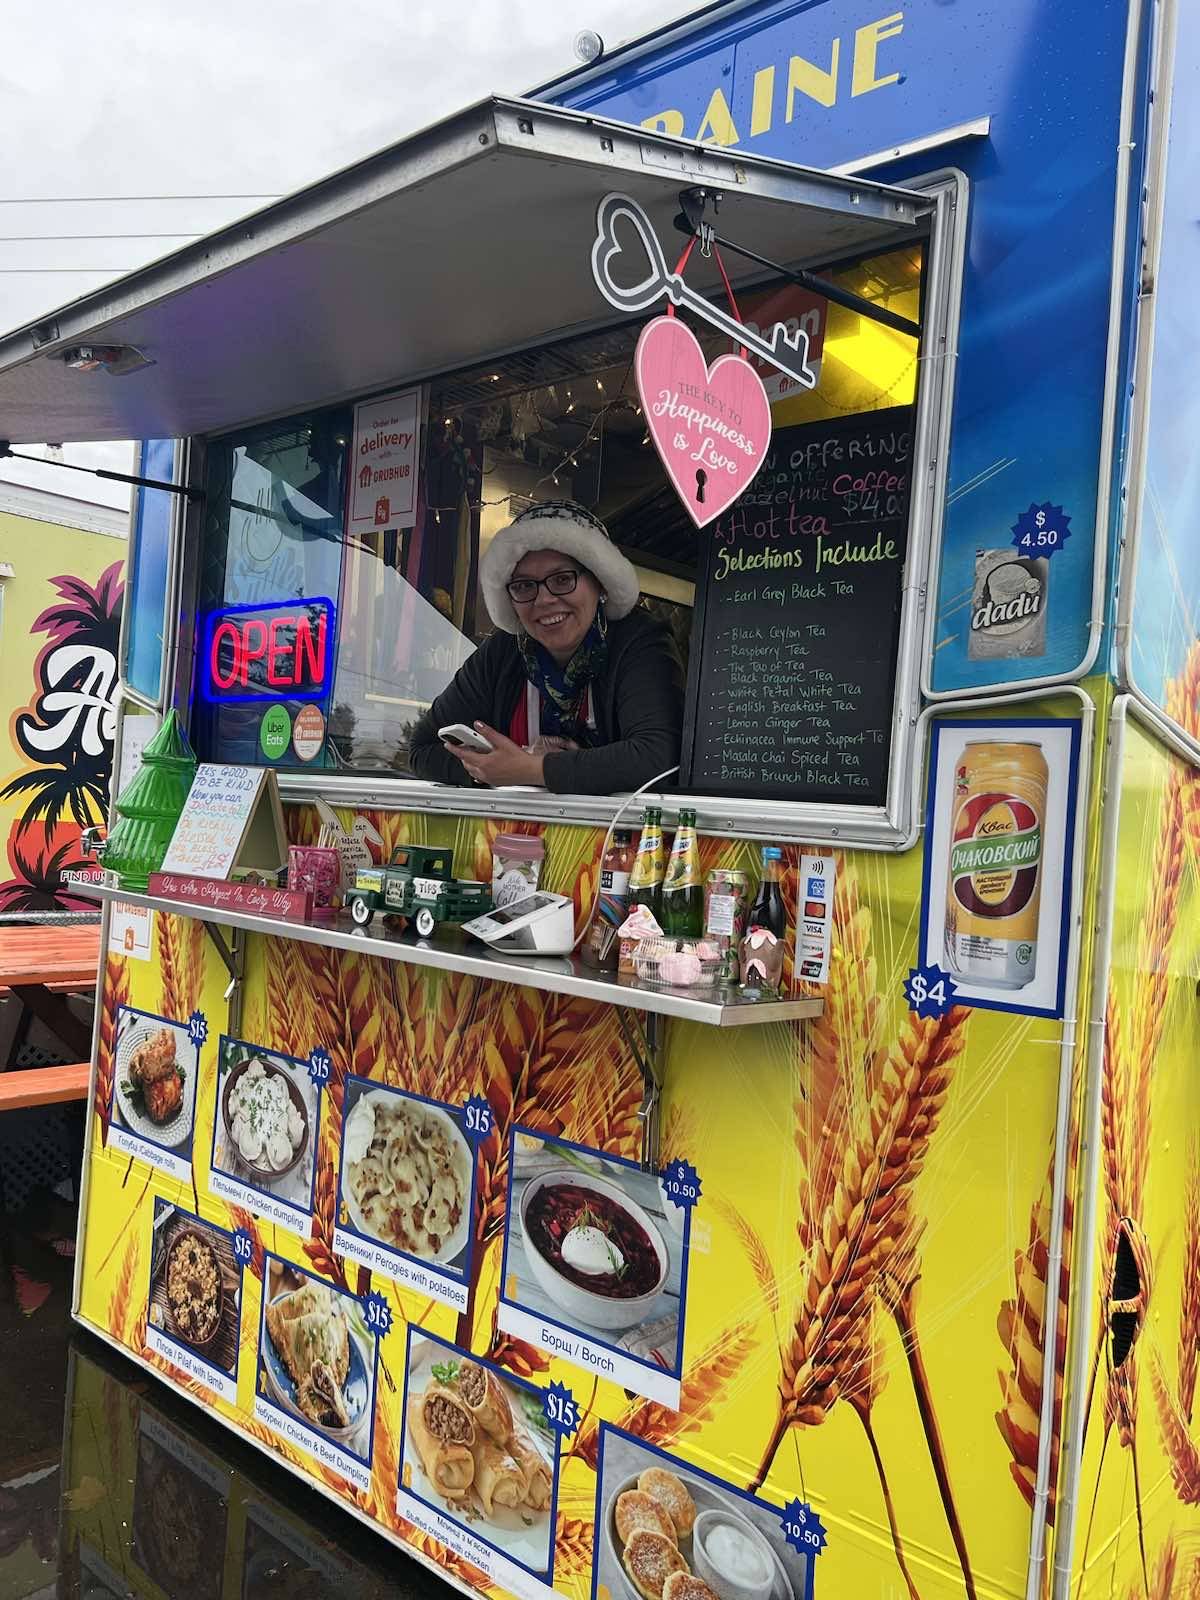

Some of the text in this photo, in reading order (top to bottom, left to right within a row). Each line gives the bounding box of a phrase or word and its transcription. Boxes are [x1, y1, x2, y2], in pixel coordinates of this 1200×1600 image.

[678, 382, 743, 425] THE KEY TO
[653, 390, 757, 456] Happiness
[360, 432, 413, 455] delivery
[673, 432, 690, 450] is
[690, 437, 738, 474] Love
[373, 464, 410, 483] GRUBHUB
[737, 481, 830, 507] azelnut
[727, 508, 780, 545] Hot
[784, 502, 832, 536] tea
[1035, 510, 1046, 528] $
[1021, 530, 1058, 547] 4.50
[715, 531, 900, 580] Selections Include
[734, 580, 855, 606] Earl Grey Black Tea
[972, 592, 1040, 631] dadu
[731, 625, 826, 643] Black Ceylon Tea
[210, 613, 328, 690] OPEN
[731, 643, 810, 660] Raspberry Tea
[728, 662, 745, 672] The
[770, 660, 783, 672] of
[784, 660, 806, 671] Tea
[730, 672, 759, 684] Black
[809, 668, 834, 682] Tea
[763, 684, 794, 697] Petal
[837, 682, 862, 695] Tea
[728, 699, 857, 718] English Breakfast Tea
[267, 721, 285, 733] Uber
[727, 716, 831, 734] Lemon Ginger Tea
[266, 734, 284, 745] Eats
[723, 732, 775, 746] Echinacea
[782, 733, 820, 746] Immune
[825, 732, 866, 749] Support
[722, 749, 860, 767] Masala Chai Spiced Tea
[195, 776, 207, 786] TO
[208, 777, 223, 788] BE
[221, 766, 249, 779] GOOD
[721, 765, 870, 787] British Brunch Black Tea
[225, 794, 242, 803] can
[978, 820, 1013, 834] Квас
[951, 834, 1039, 872] ОЧАКОВСКИЙ
[60, 869, 91, 883] FIND
[160, 876, 178, 894] You
[180, 879, 199, 896] Are
[246, 888, 269, 912] Every
[272, 892, 292, 914] Way
[806, 924, 823, 934] VISA
[909, 973, 947, 1008] $4
[190, 1019, 206, 1040] $15
[310, 1054, 330, 1078] $15
[465, 1105, 490, 1133] $15
[678, 1166, 685, 1181] $
[667, 1179, 696, 1198] 10.50
[247, 1193, 273, 1213] Chicken
[273, 1207, 304, 1231] dumpling
[234, 1234, 252, 1259] $15
[375, 1252, 410, 1278] Perogies
[411, 1270, 428, 1287] with
[429, 1280, 466, 1305] potatoes
[366, 1300, 390, 1329] $15
[541, 1328, 572, 1357] Борщ
[581, 1346, 615, 1373] Borch
[177, 1351, 192, 1369] Pilaf
[192, 1364, 206, 1380] with
[207, 1371, 224, 1391] lamb
[546, 1392, 575, 1427] $15
[287, 1424, 313, 1449] Chicken
[319, 1445, 336, 1463] Beef
[336, 1456, 369, 1488] Dumpling
[798, 1508, 807, 1526] $
[785, 1521, 820, 1547] 10.50
[464, 1550, 490, 1572] chicken
